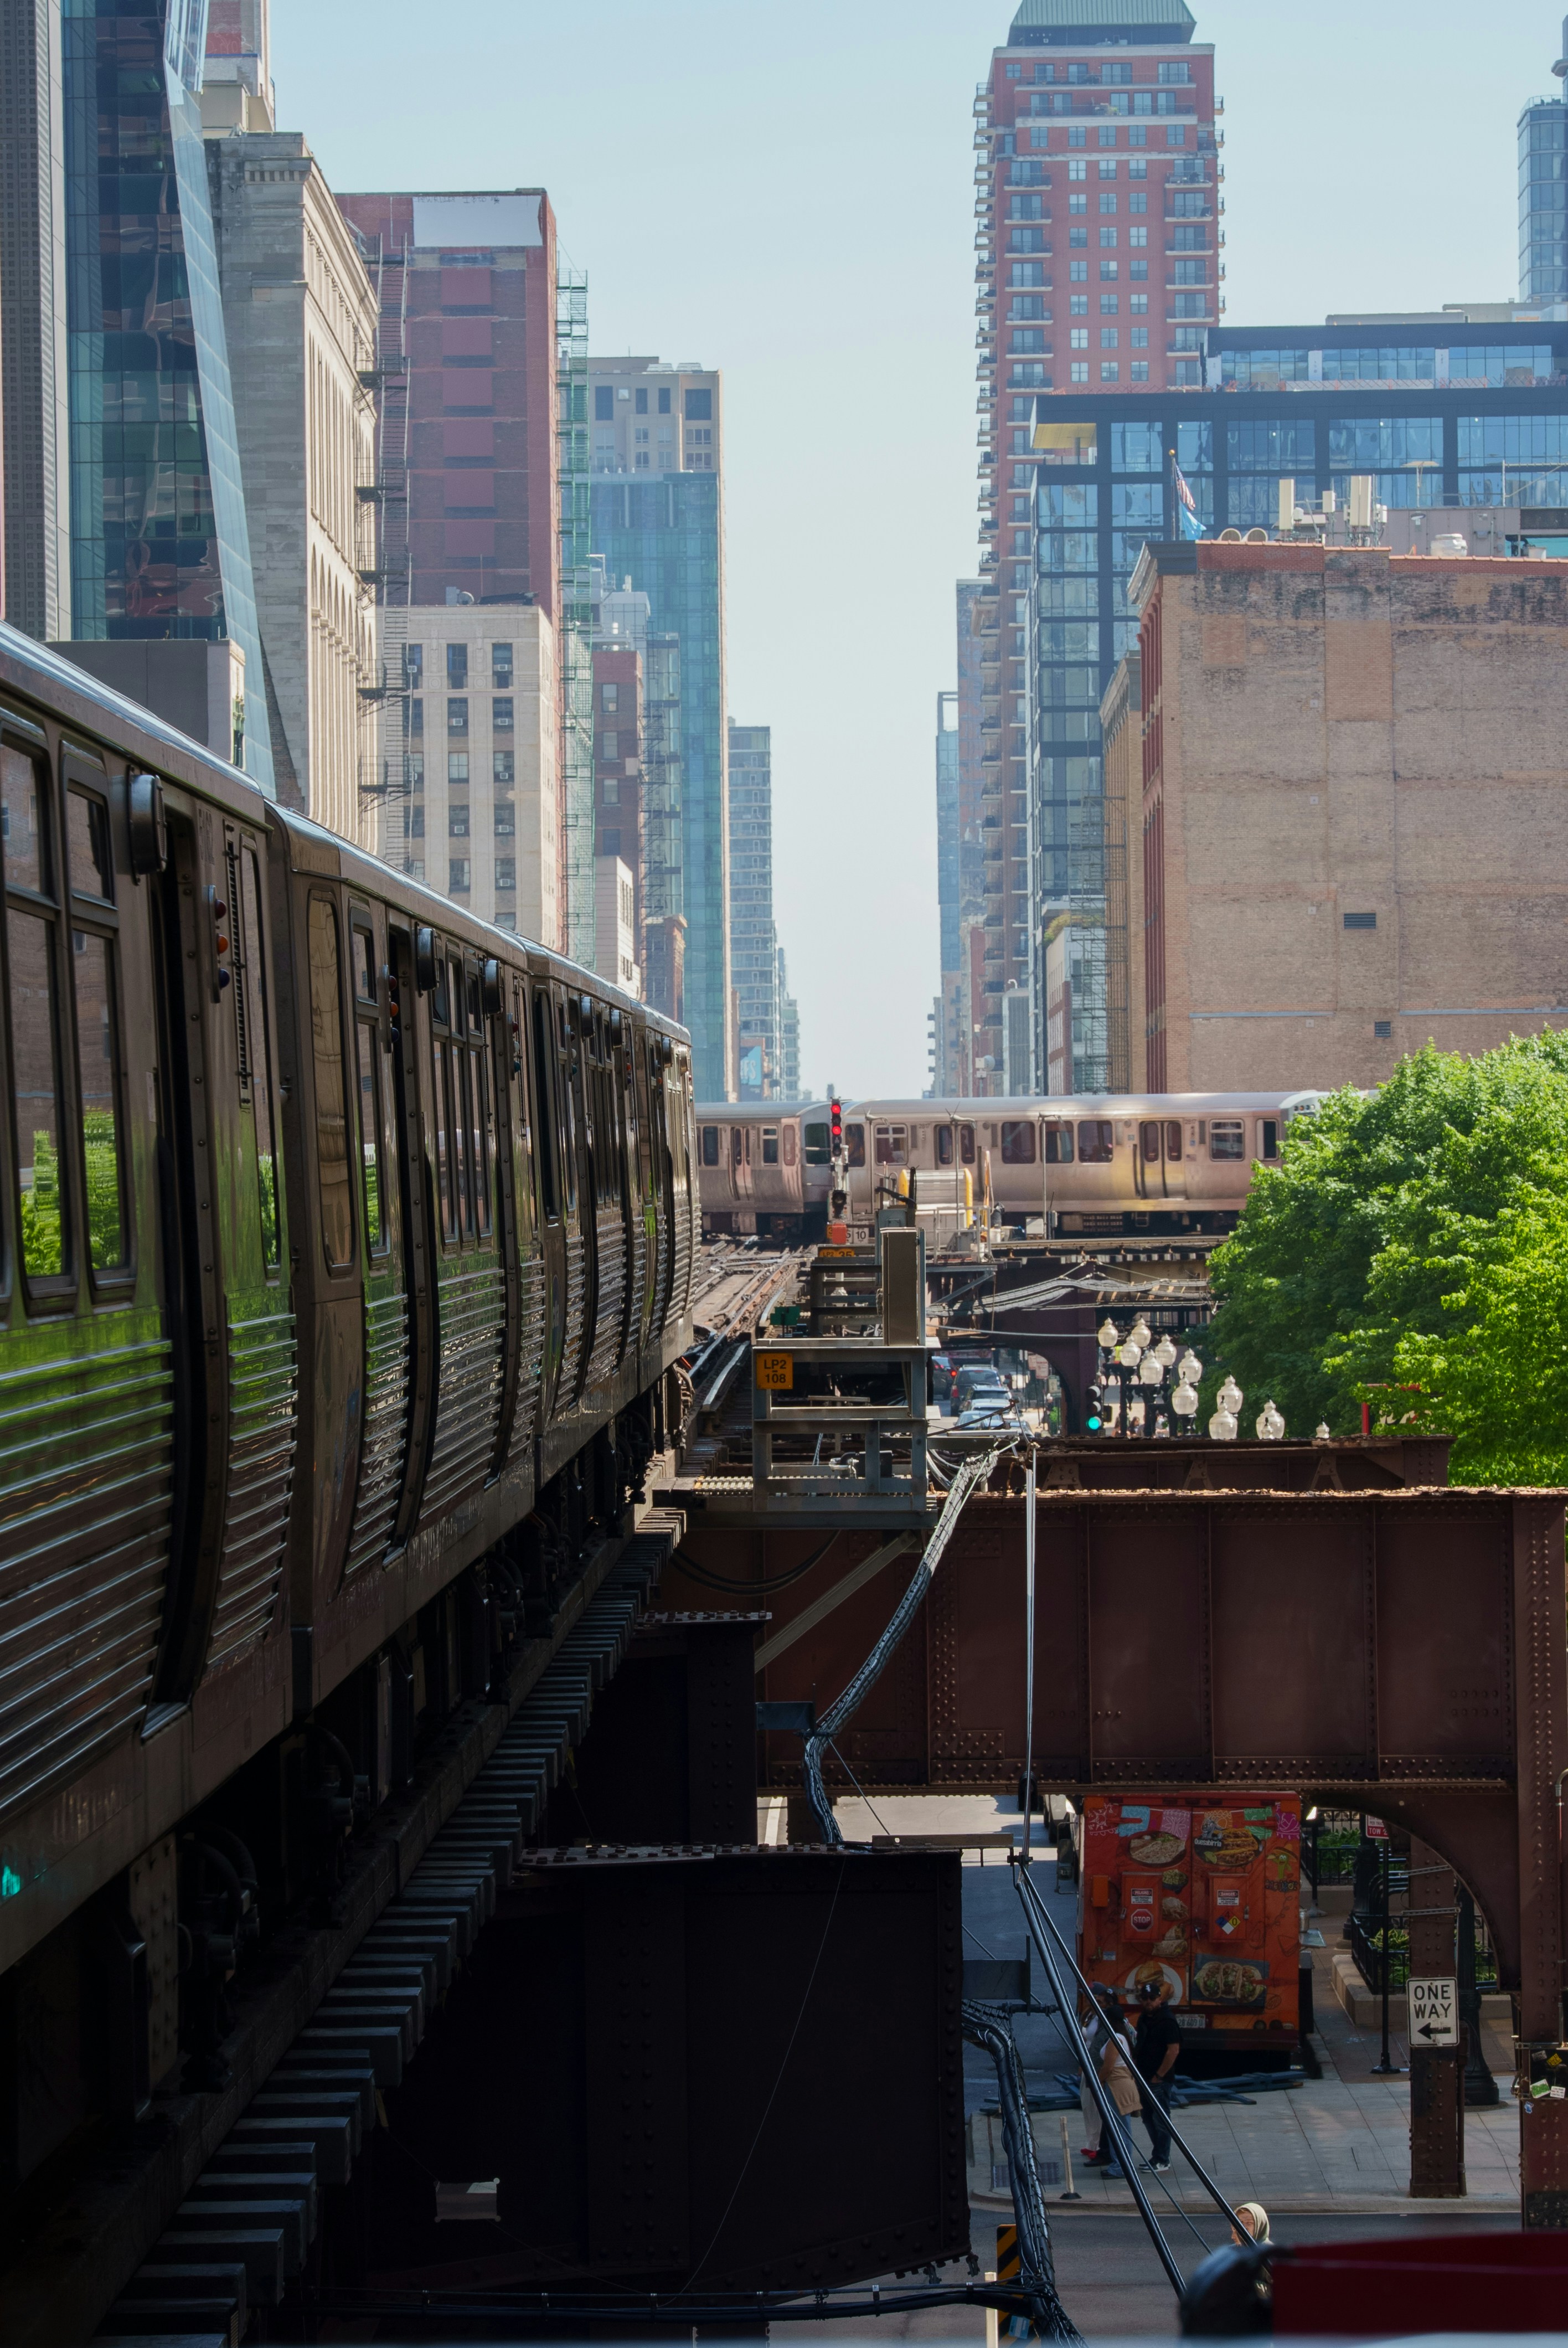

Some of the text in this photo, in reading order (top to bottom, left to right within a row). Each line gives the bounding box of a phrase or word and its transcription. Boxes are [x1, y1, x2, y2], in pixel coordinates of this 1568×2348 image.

[855, 1230, 866, 1240] 10
[764, 1359, 787, 1369] LP2
[765, 1373, 786, 1383] 108
[1231, 1917, 1237, 1926] 0
[1414, 1984, 1451, 2001] ONE
[1413, 2003, 1452, 2019] WAY
